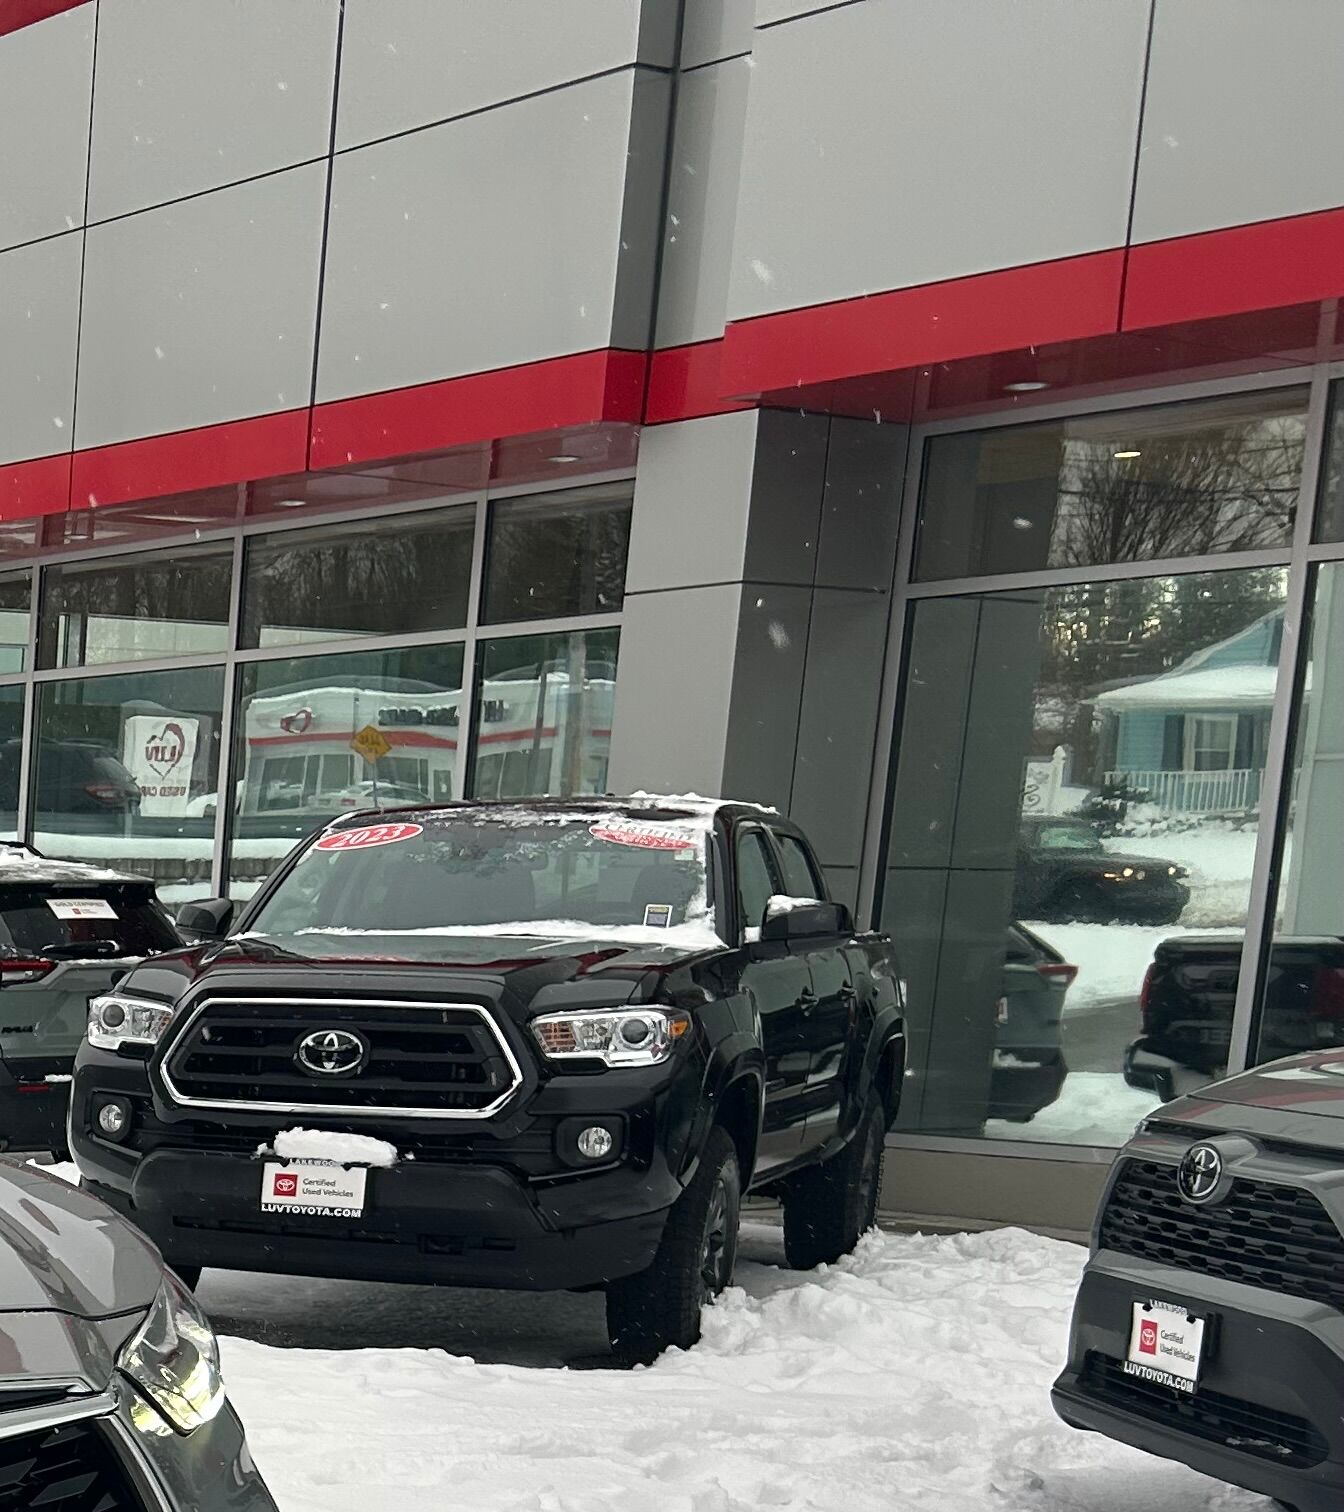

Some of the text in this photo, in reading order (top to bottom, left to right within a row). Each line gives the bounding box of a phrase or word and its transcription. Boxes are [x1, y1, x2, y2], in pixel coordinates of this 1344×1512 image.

[330, 823, 406, 848] 2023
[303, 1178, 336, 1187] Certified
[323, 1189, 353, 1197] Vehicles
[261, 1203, 362, 1218] LUVTOYOTA.COM
[1123, 1361, 1194, 1394] LUVTOYOTA.COM
